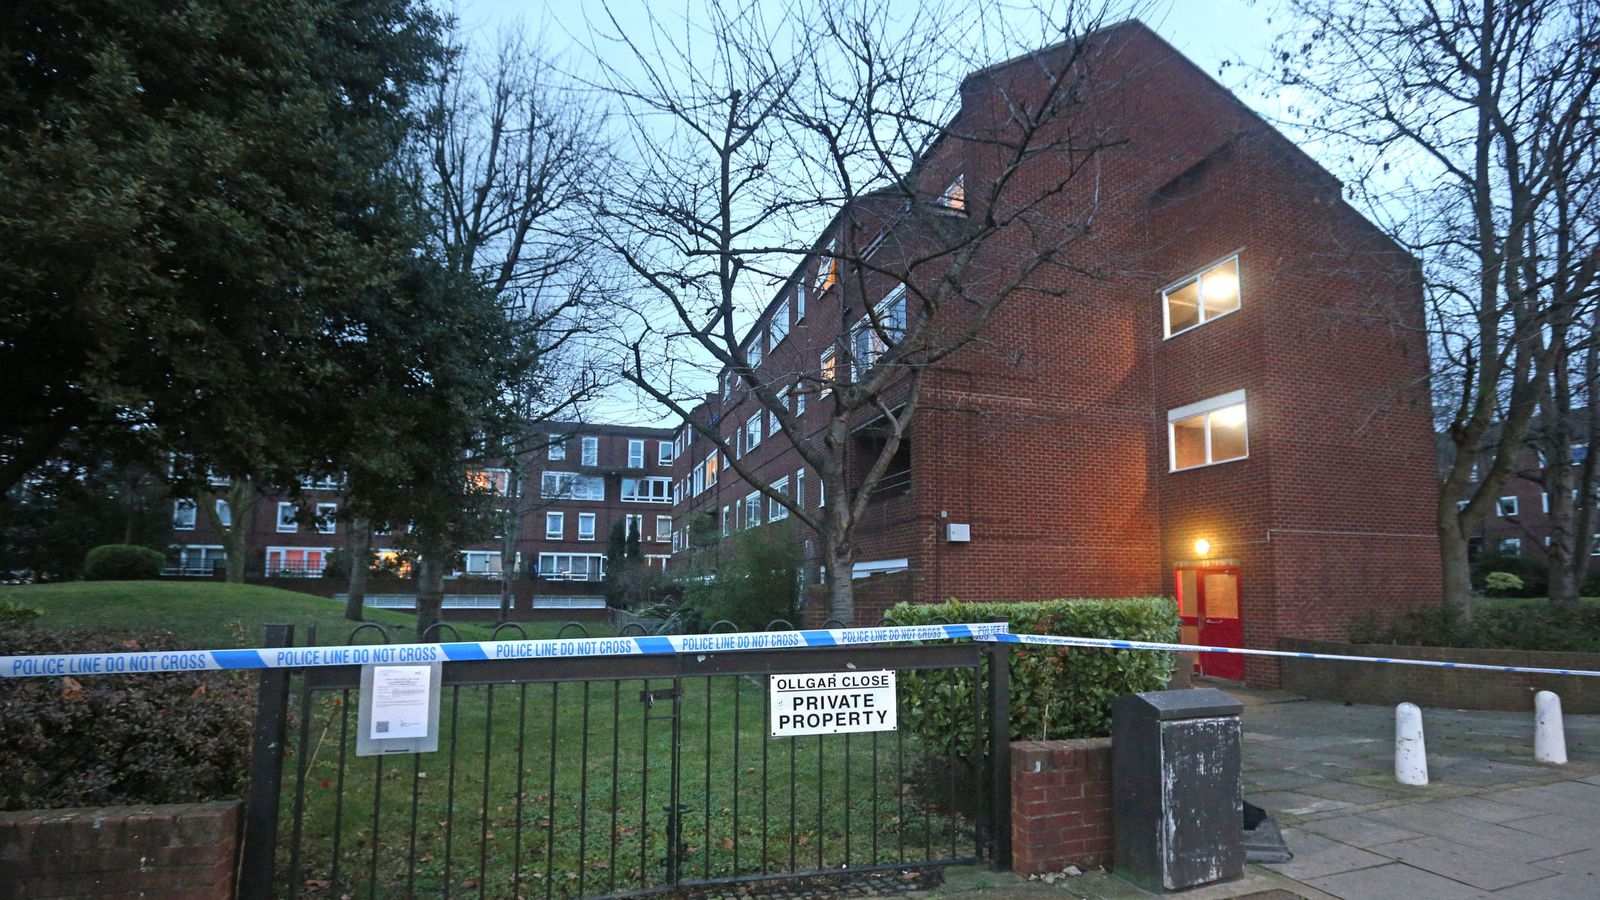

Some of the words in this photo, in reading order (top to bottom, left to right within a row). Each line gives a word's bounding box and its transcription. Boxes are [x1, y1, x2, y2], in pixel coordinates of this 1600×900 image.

[683, 637, 713, 650] POLICE
[716, 636, 735, 649] LINE
[738, 636, 750, 648] DO
[752, 635, 768, 647] NOT
[771, 634, 799, 646] CROSS
[842, 631, 868, 643] POLICE
[870, 630, 887, 641] LINE
[889, 630, 899, 640] DO
[902, 629, 916, 640] NOT
[918, 628, 941, 639] CROSS
[277, 650, 320, 666] POLICE
[324, 650, 349, 664] LINE
[353, 649, 369, 663] DO
[373, 648, 396, 662] NOT
[400, 647, 436, 662] CROSS
[496, 644, 532, 657] POLICE
[536, 642, 557, 656] LINE
[561, 642, 574, 655] DO
[577, 641, 597, 655] NOT
[600, 640, 631, 654] CROSS
[13, 659, 65, 675] POLICE
[69, 658, 100, 673] LINE
[105, 656, 125, 672] DO
[129, 655, 158, 671] NOT
[161, 654, 206, 670] CROSS
[777, 677, 836, 689] OLLGAR
[842, 675, 889, 686] CLOSE
[793, 694, 874, 711] PRIVATE
[780, 710, 887, 729] PROPERTY
